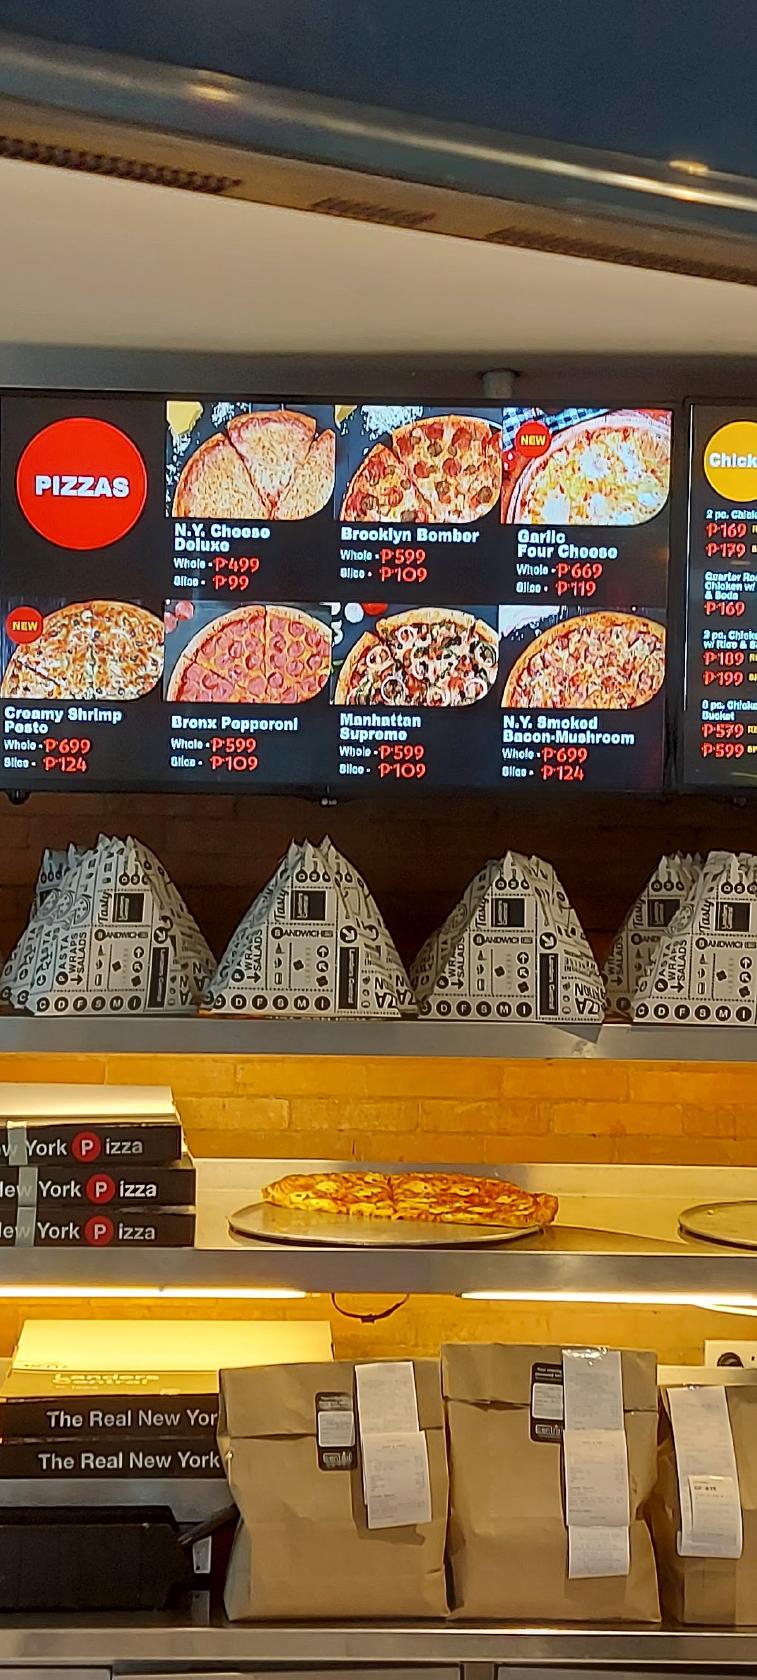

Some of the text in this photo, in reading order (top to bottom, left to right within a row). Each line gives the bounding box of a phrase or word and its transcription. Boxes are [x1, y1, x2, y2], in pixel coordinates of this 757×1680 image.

[520, 434, 546, 447] NEW
[35, 475, 130, 498] PIZZAS
[174, 523, 206, 538] N.Y.
[341, 527, 412, 545] Brooklyn
[517, 529, 566, 544] Garlic
[517, 544, 554, 558] Four
[12, 620, 38, 632] NEW
[4, 707, 122, 725] Creamy Shrimp
[171, 716, 298, 732] Bronx Pepperoni
[340, 713, 421, 728] Manhattan
[503, 716, 598, 730] N.Y. Smoked
[4, 722, 49, 735] Pesto
[76, 932, 87, 973] SALADS
[26, 1139, 68, 1156] York
[0, 1181, 32, 1197] ew
[39, 1180, 82, 1198] York
[37, 1222, 80, 1240] York
[46, 1409, 218, 1428] The Real New Yor
[38, 1451, 220, 1470] The Real New York
